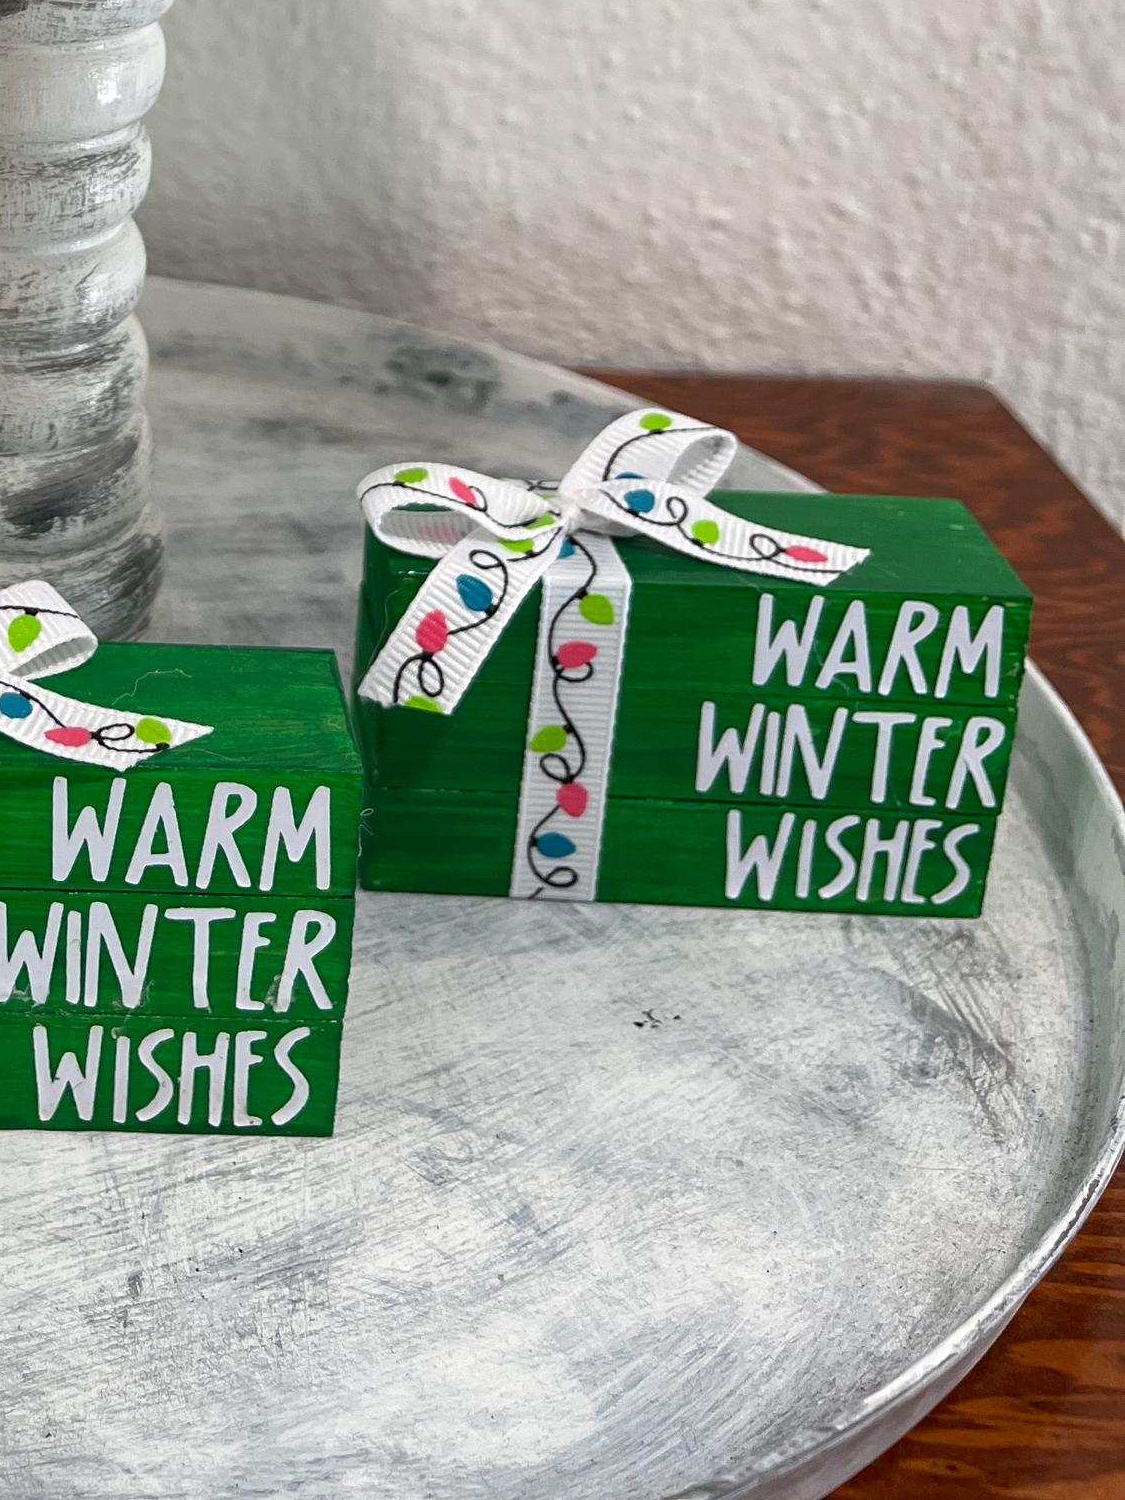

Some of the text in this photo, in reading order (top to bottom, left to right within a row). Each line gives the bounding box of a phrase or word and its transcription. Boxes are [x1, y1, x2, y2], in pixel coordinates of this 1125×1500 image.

[752, 593, 1004, 699] WARM
[696, 701, 1006, 809] WINTER
[52, 776, 331, 892] WARM
[725, 809, 980, 905] WISHES
[32, 1025, 312, 1128] WISHES
